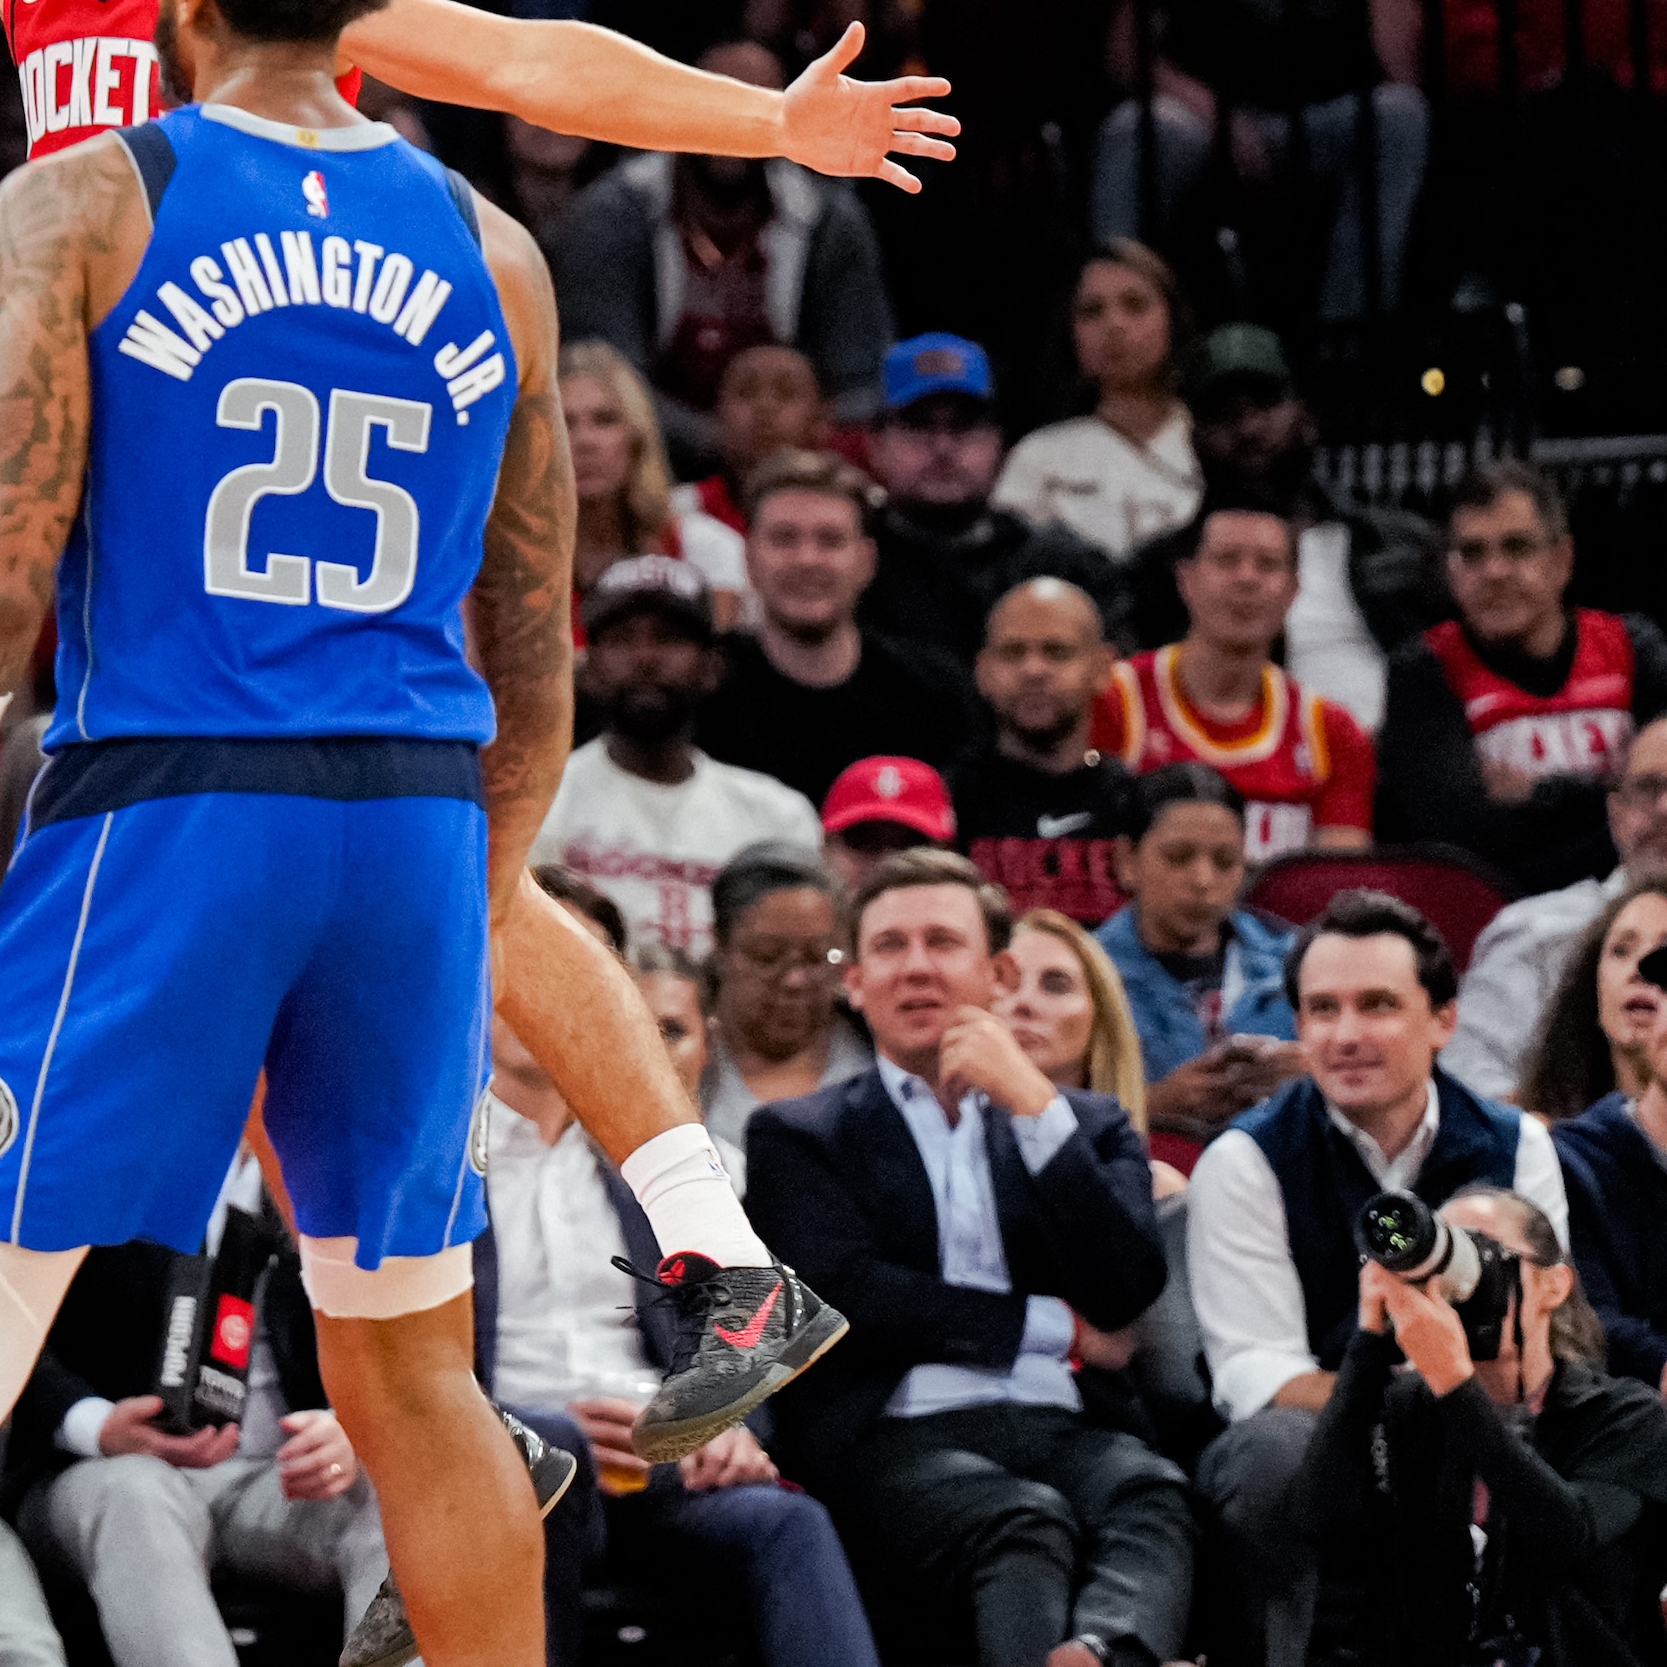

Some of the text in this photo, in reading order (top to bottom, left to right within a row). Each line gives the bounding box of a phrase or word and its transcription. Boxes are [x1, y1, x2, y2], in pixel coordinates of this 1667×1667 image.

[19, 36, 164, 146] OCKET
[118, 231, 507, 426] WASHINGTON JR.
[205, 377, 432, 614] 25
